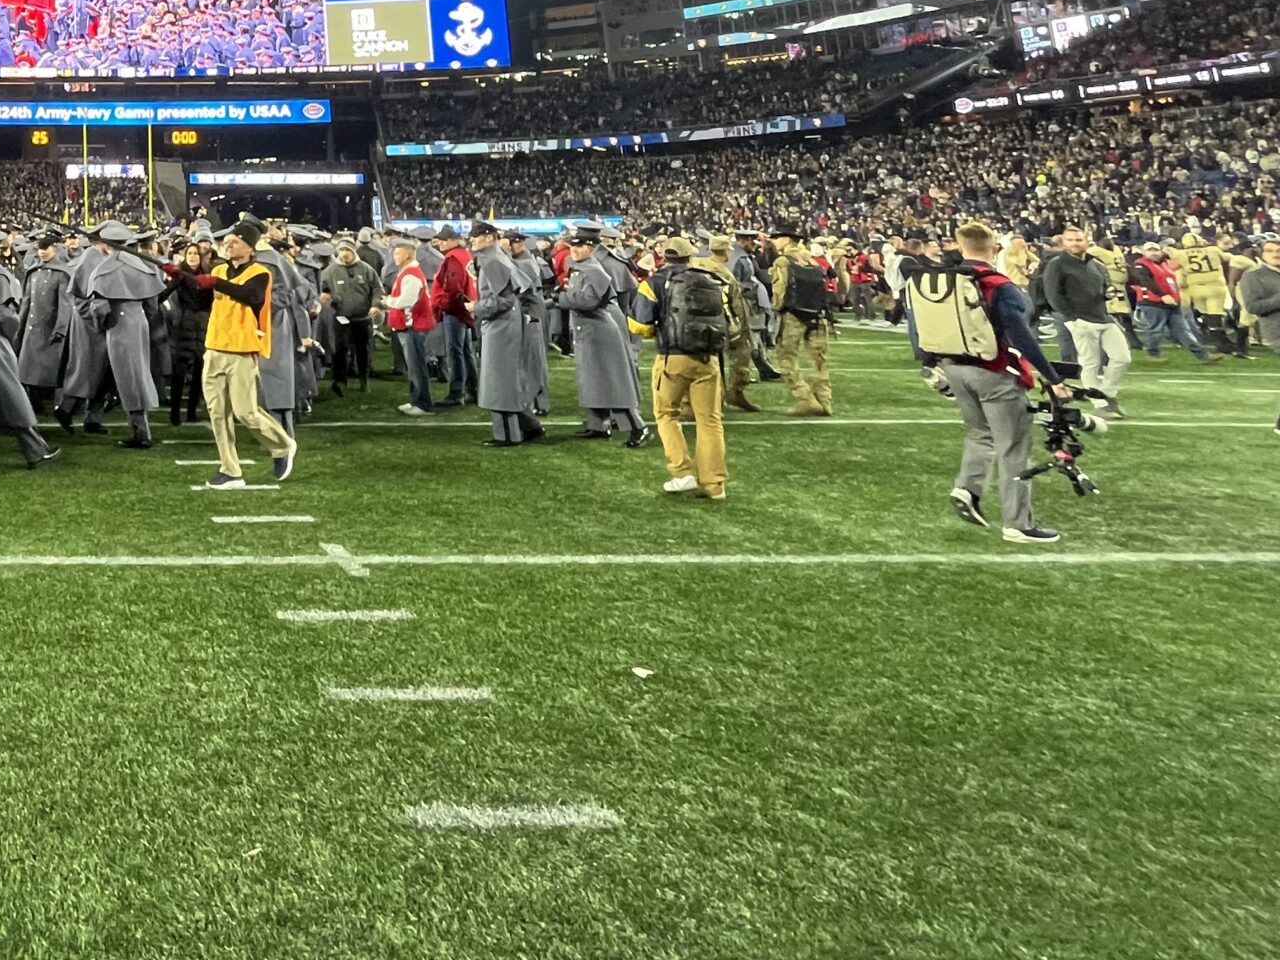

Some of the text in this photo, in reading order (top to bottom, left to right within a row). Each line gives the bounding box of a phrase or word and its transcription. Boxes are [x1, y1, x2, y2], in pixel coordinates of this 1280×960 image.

[35, 106, 110, 121] Army-Navy
[114, 107, 154, 119] Game
[157, 106, 225, 120] presented
[229, 105, 245, 120] by
[249, 104, 292, 118] USAA
[172, 131, 197, 145] 0:00
[1187, 255, 1219, 273] 51
